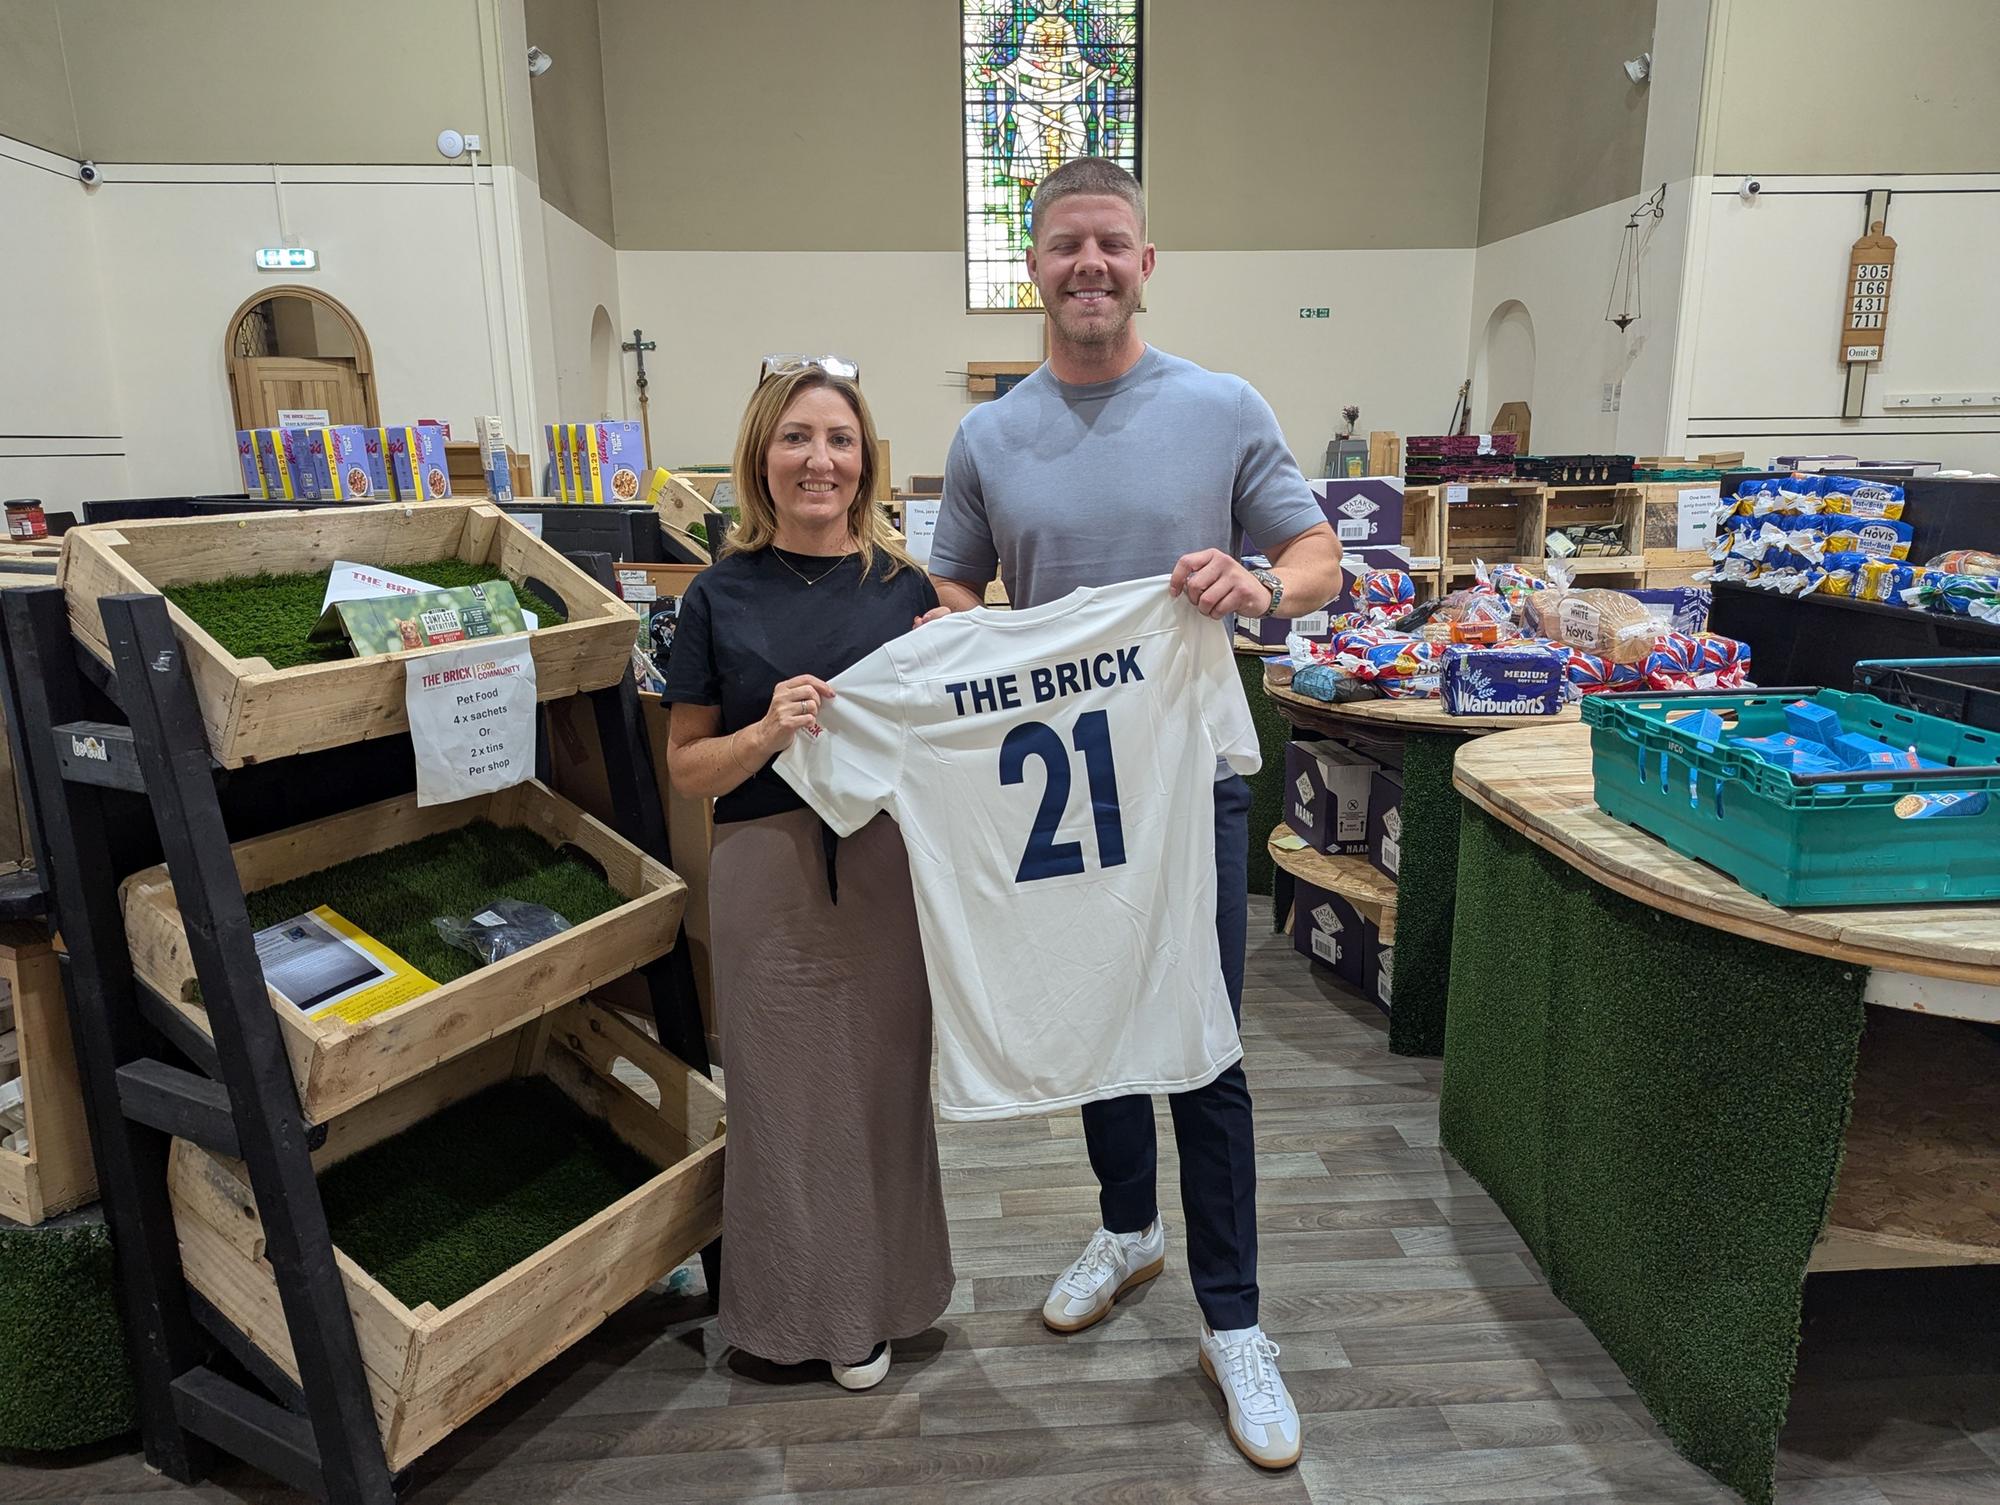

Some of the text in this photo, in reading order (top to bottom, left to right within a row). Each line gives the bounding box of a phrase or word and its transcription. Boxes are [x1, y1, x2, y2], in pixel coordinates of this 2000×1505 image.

[1859, 265, 1889, 278] 305
[1857, 281, 1885, 295] 166
[1854, 298, 1882, 311] 431
[1854, 314, 1879, 328] 711
[1848, 348, 1869, 357] Omit
[596, 424, 609, 464] Kellogg's
[590, 452, 599, 477] £3.29
[1855, 489, 1886, 501] HOVIS
[1863, 528, 1895, 541] HOVIS
[352, 571, 383, 586] THE
[424, 611, 456, 624] COMPLETE
[1570, 610, 1589, 620] WHITE
[428, 621, 459, 631] NUTRITION
[1565, 624, 1594, 642] HOVIS
[476, 661, 496, 673] FOOD
[477, 664, 521, 681] COMMUNITY
[1417, 663, 1440, 676] HO
[422, 673, 441, 688] THE
[443, 667, 472, 683] BRICK
[945, 645, 1145, 716] THE BRICK
[1503, 670, 1549, 679] MEDIUM
[456, 688, 499, 706] Pet Food
[1459, 691, 1545, 714] Warburtons
[453, 705, 508, 724] 4 x sachets
[479, 727, 491, 737] Or
[470, 742, 504, 758] 2 x tins
[469, 759, 510, 776] Per shop
[999, 709, 1127, 884] 21
